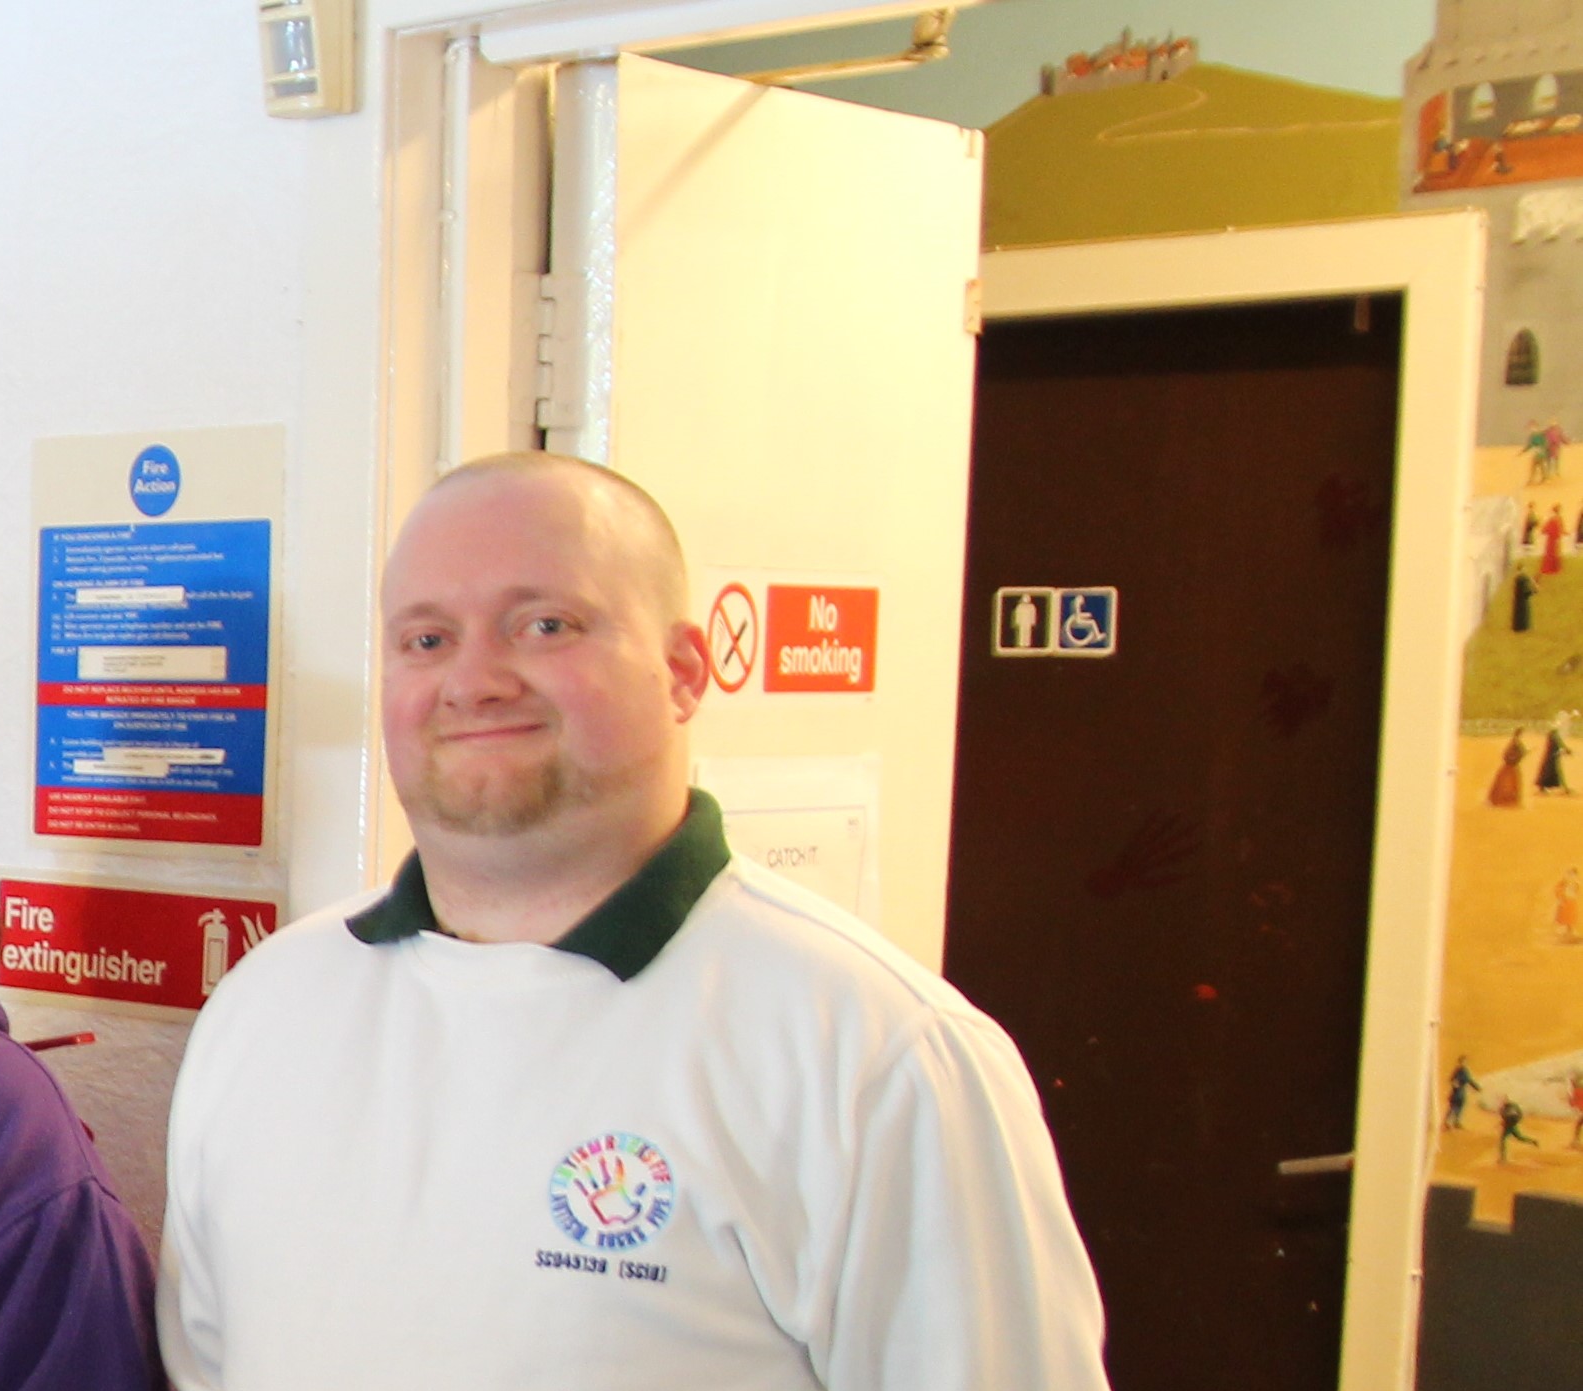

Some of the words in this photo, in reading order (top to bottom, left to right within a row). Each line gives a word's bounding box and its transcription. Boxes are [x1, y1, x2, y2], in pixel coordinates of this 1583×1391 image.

[142, 459, 169, 475] Fire
[135, 478, 176, 494] Action
[808, 595, 838, 631] No
[779, 638, 862, 683] smoking
[4, 897, 54, 932] Fire
[2, 940, 167, 986] extinguisher
